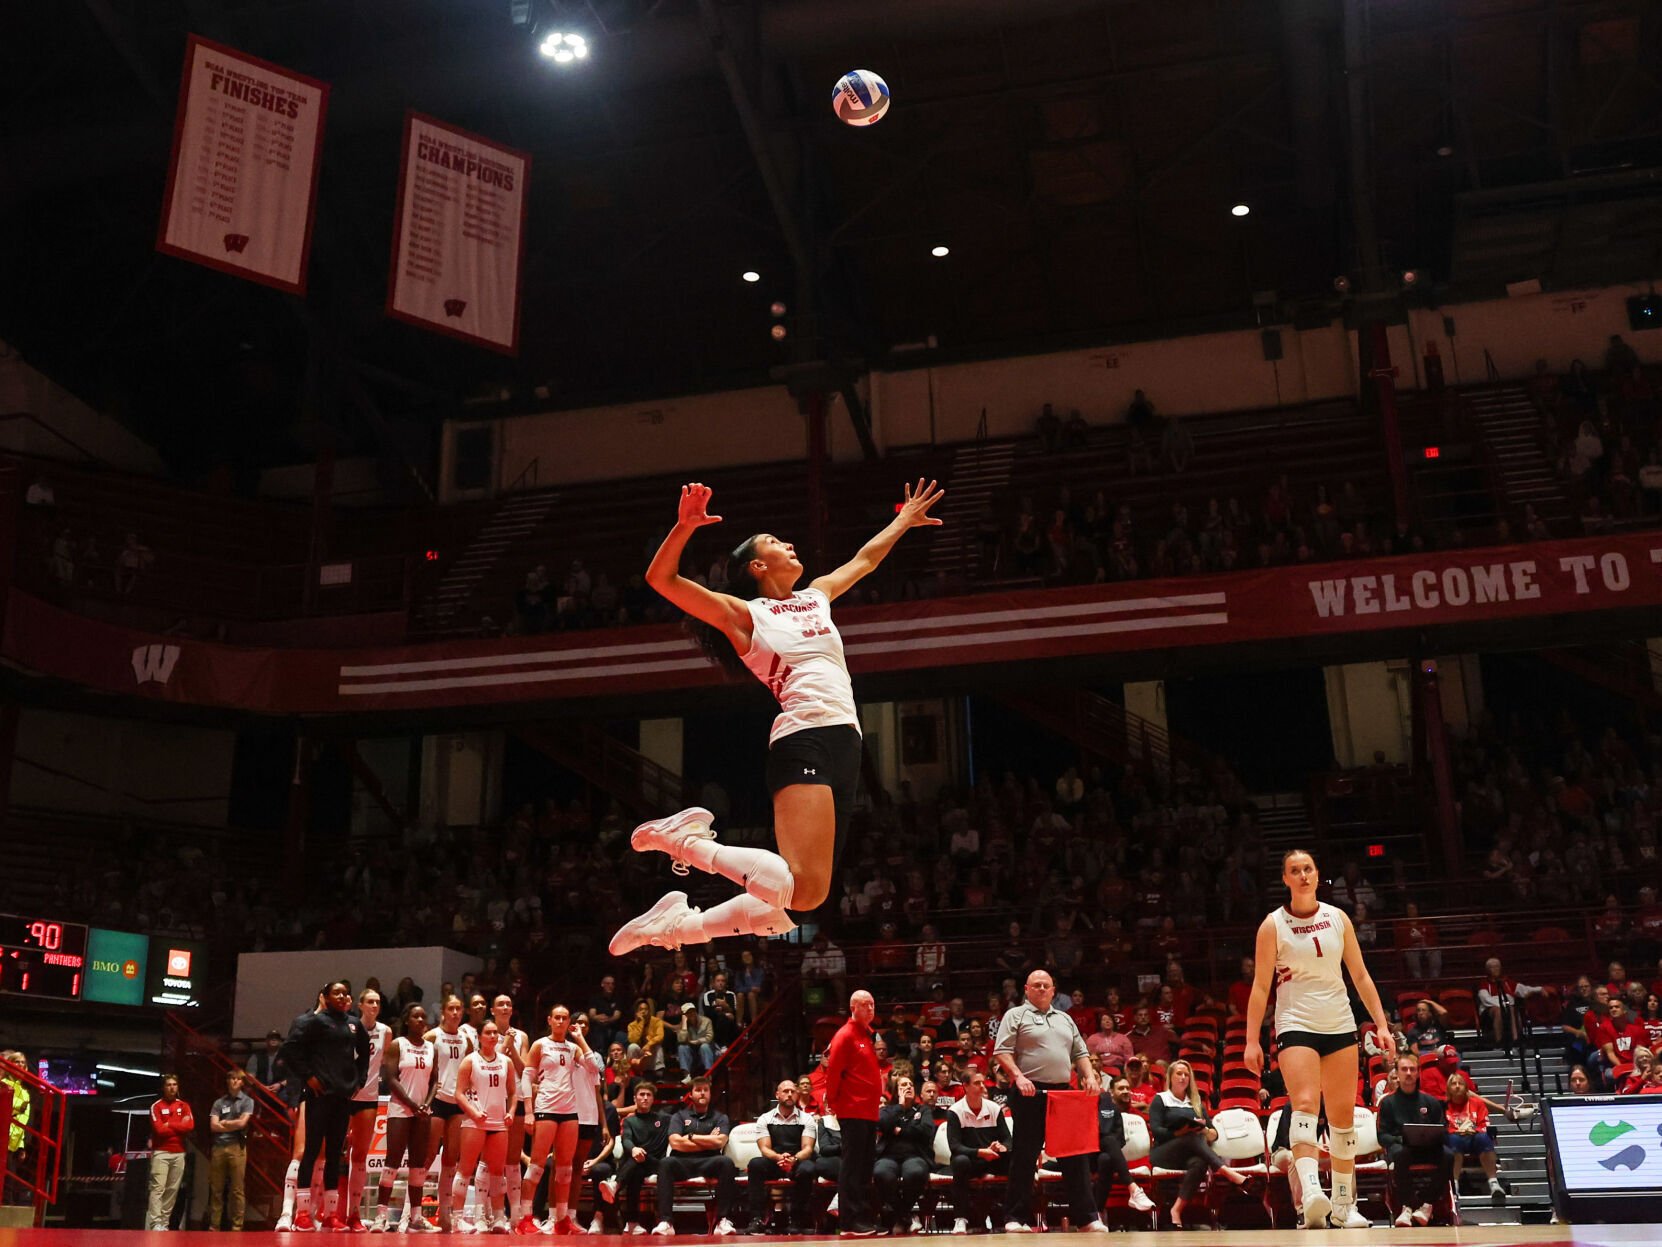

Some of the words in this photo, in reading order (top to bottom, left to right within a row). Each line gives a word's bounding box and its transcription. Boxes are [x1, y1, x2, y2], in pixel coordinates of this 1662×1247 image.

[210, 73, 298, 119] FINISHES
[418, 142, 514, 192] CHAMPIONS
[1308, 560, 1541, 618] WELCOME
[1559, 552, 1630, 594] TO
[131, 643, 182, 687] W
[1291, 920, 1331, 934] WISCONSIN
[1312, 936, 1323, 958] 1
[44, 952, 82, 968] PANTHERS
[92, 960, 120, 973] BMO
[162, 978, 192, 989] TOYOTA
[450, 1046, 459, 1059] 10
[560, 1054, 566, 1066] 8
[415, 1056, 426, 1070] 16
